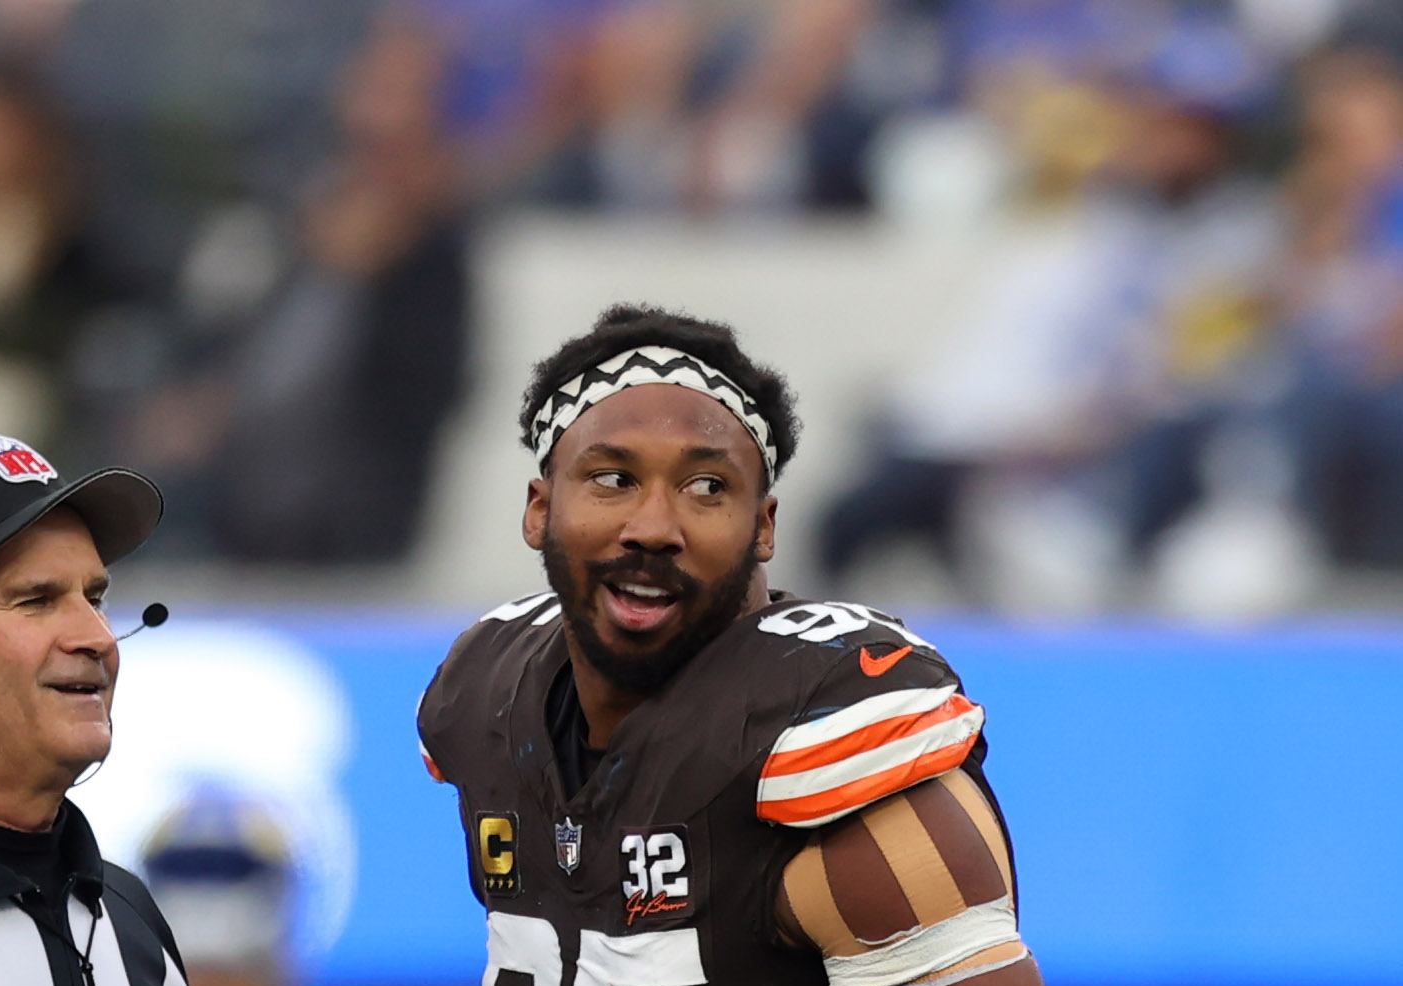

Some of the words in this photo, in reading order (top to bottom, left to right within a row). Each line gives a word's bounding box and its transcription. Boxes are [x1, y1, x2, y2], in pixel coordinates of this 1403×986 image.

[479, 817, 514, 875] C
[558, 843, 578, 867] NFL
[621, 832, 689, 900] 32
